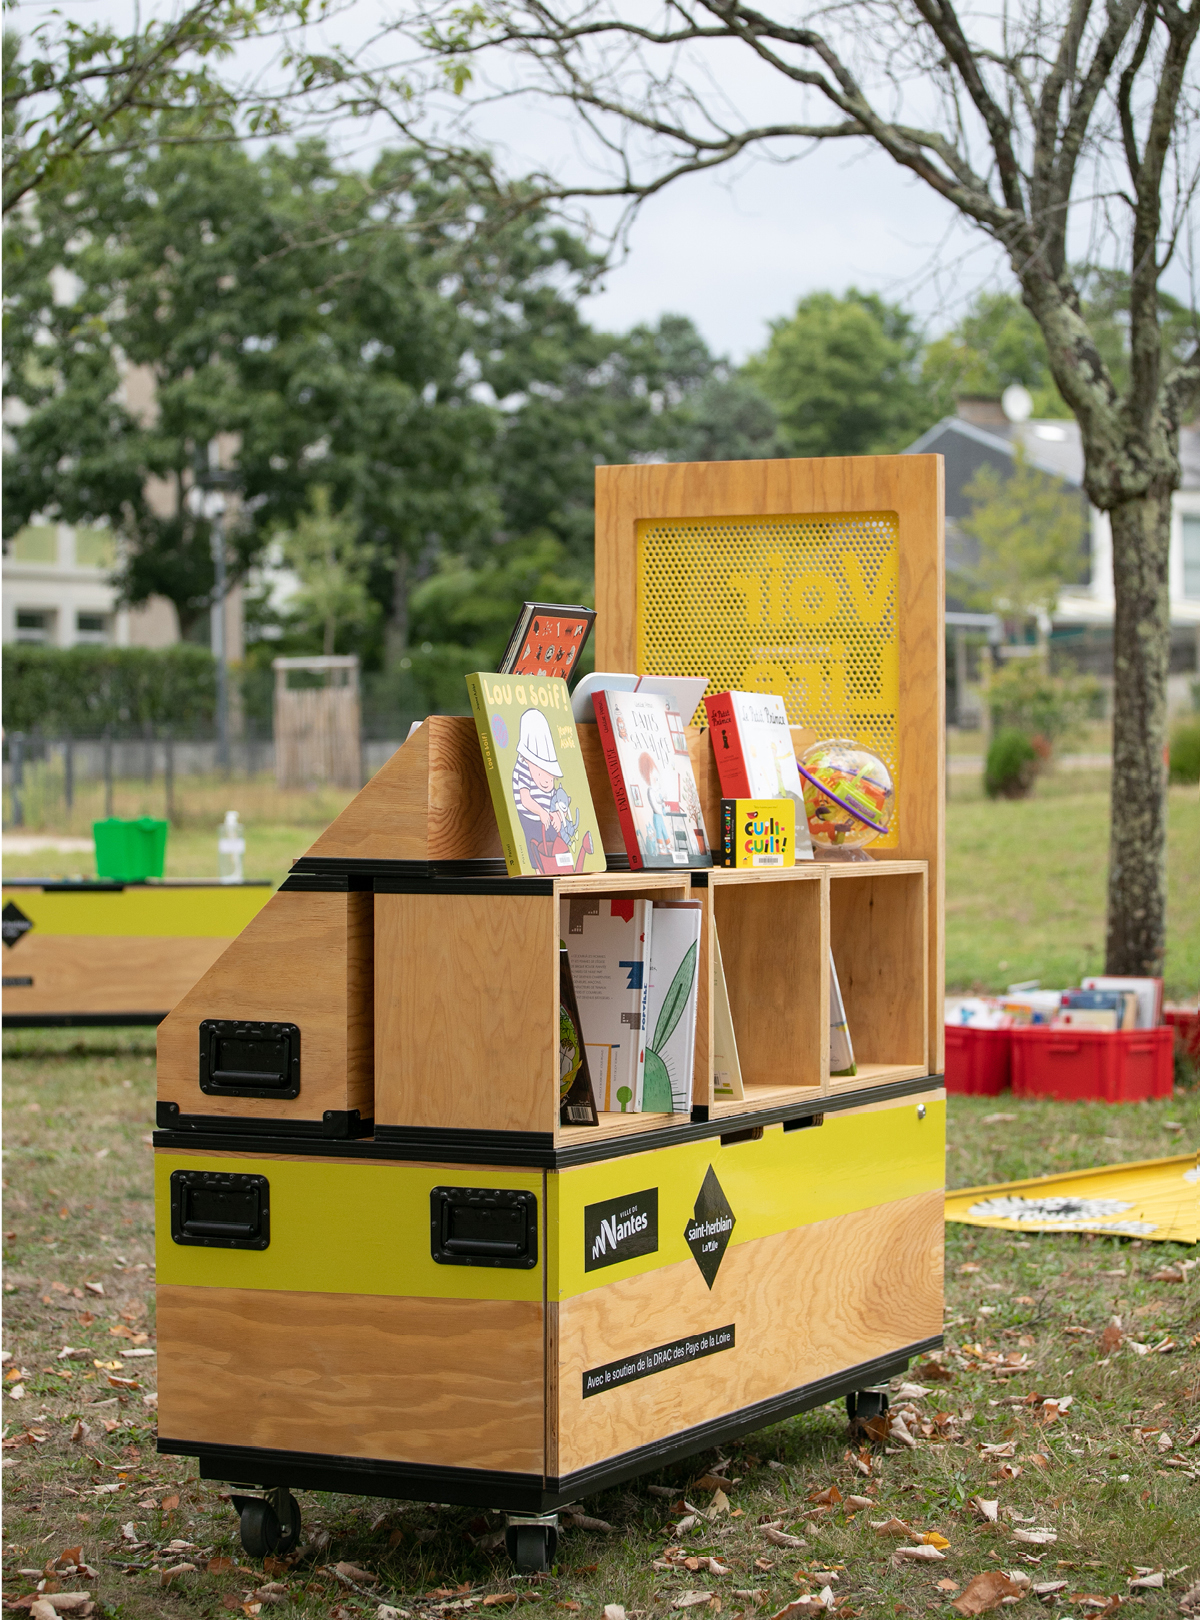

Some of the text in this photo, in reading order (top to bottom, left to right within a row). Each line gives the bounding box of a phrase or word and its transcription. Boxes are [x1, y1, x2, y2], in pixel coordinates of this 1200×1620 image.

[483, 679, 513, 706] Lou
[515, 684, 528, 706] a
[764, 706, 786, 726] Prince
[619, 1207, 632, 1219] VILLE
[592, 1212, 648, 1260] Nantes
[688, 1214, 732, 1241] saint-herblain
[586, 1332, 731, 1389] Avec le soutien de la DRAC des Pays de la Loire
